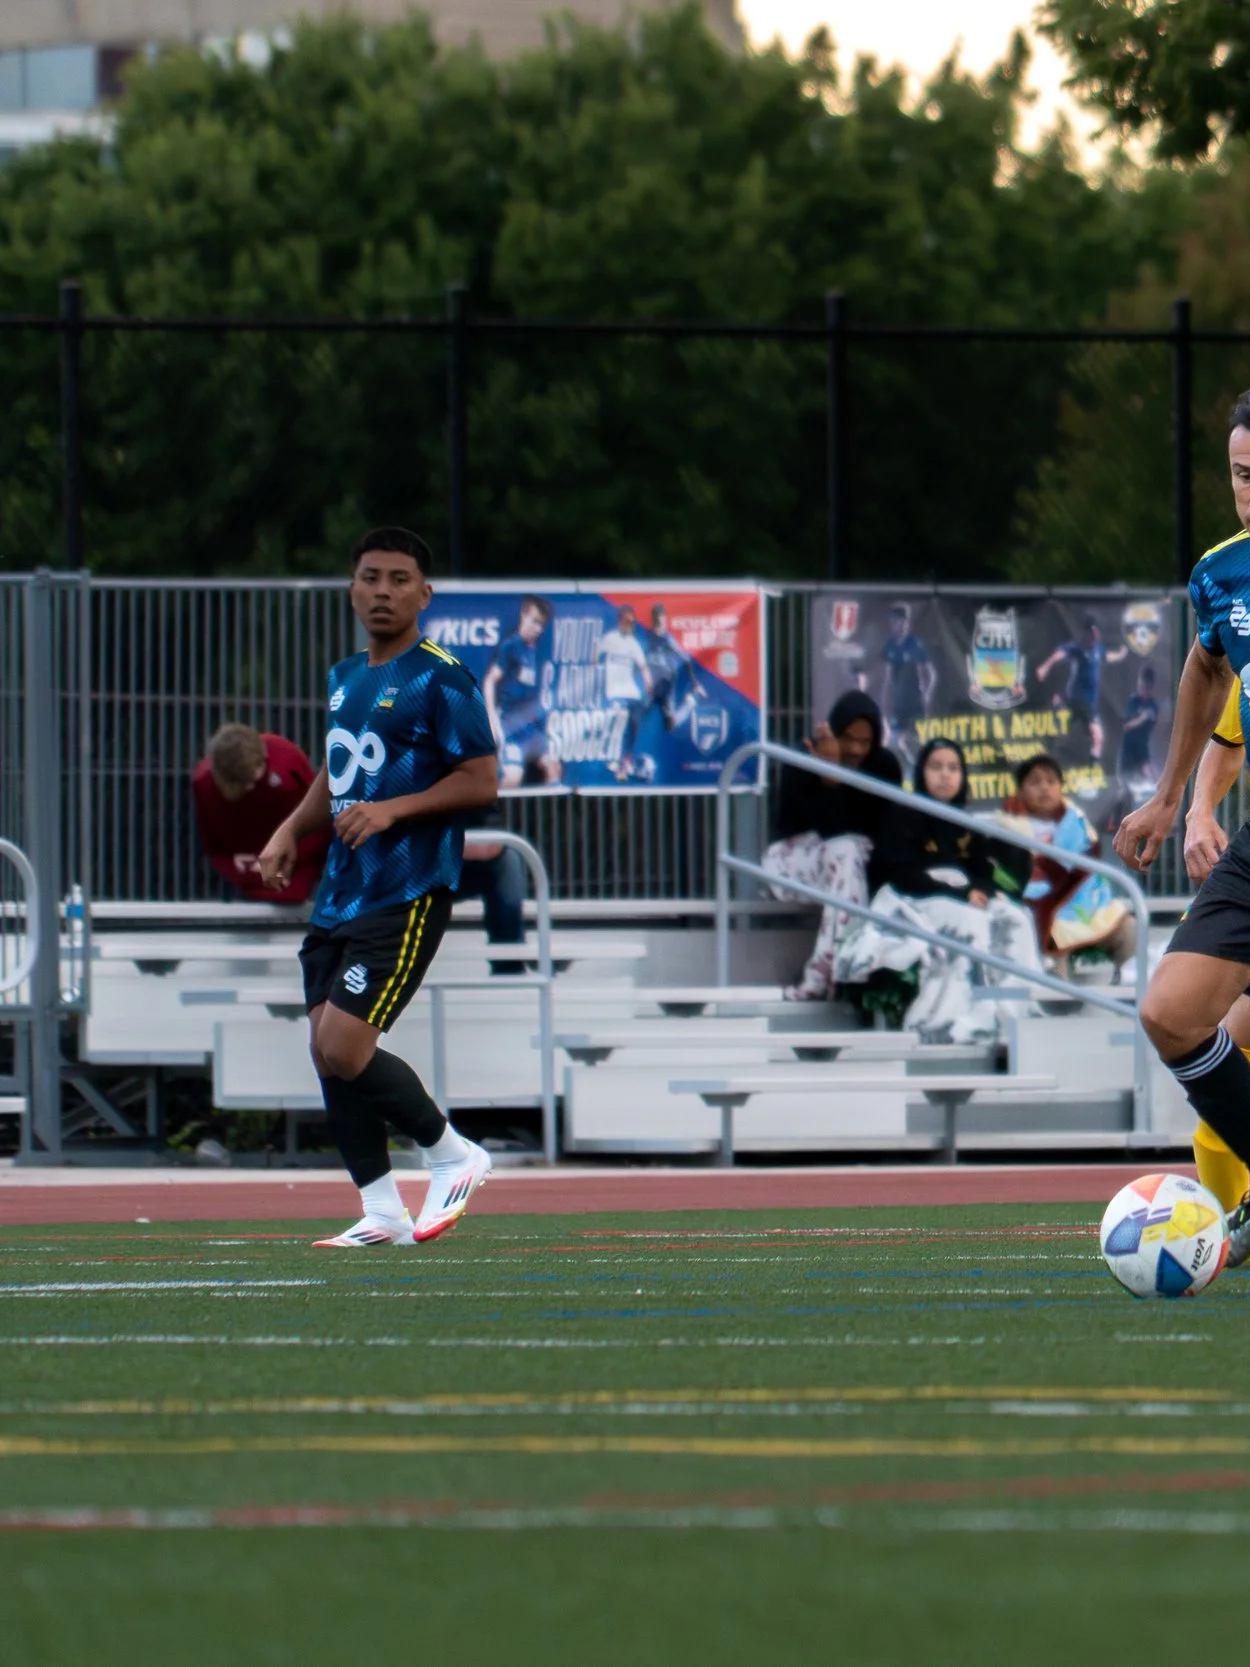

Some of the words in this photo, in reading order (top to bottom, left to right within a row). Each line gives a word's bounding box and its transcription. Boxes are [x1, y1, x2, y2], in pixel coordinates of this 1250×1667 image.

[547, 708, 630, 763] SOCCER
[915, 715, 988, 745] YOUTH
[1010, 708, 1072, 738] ADULT
